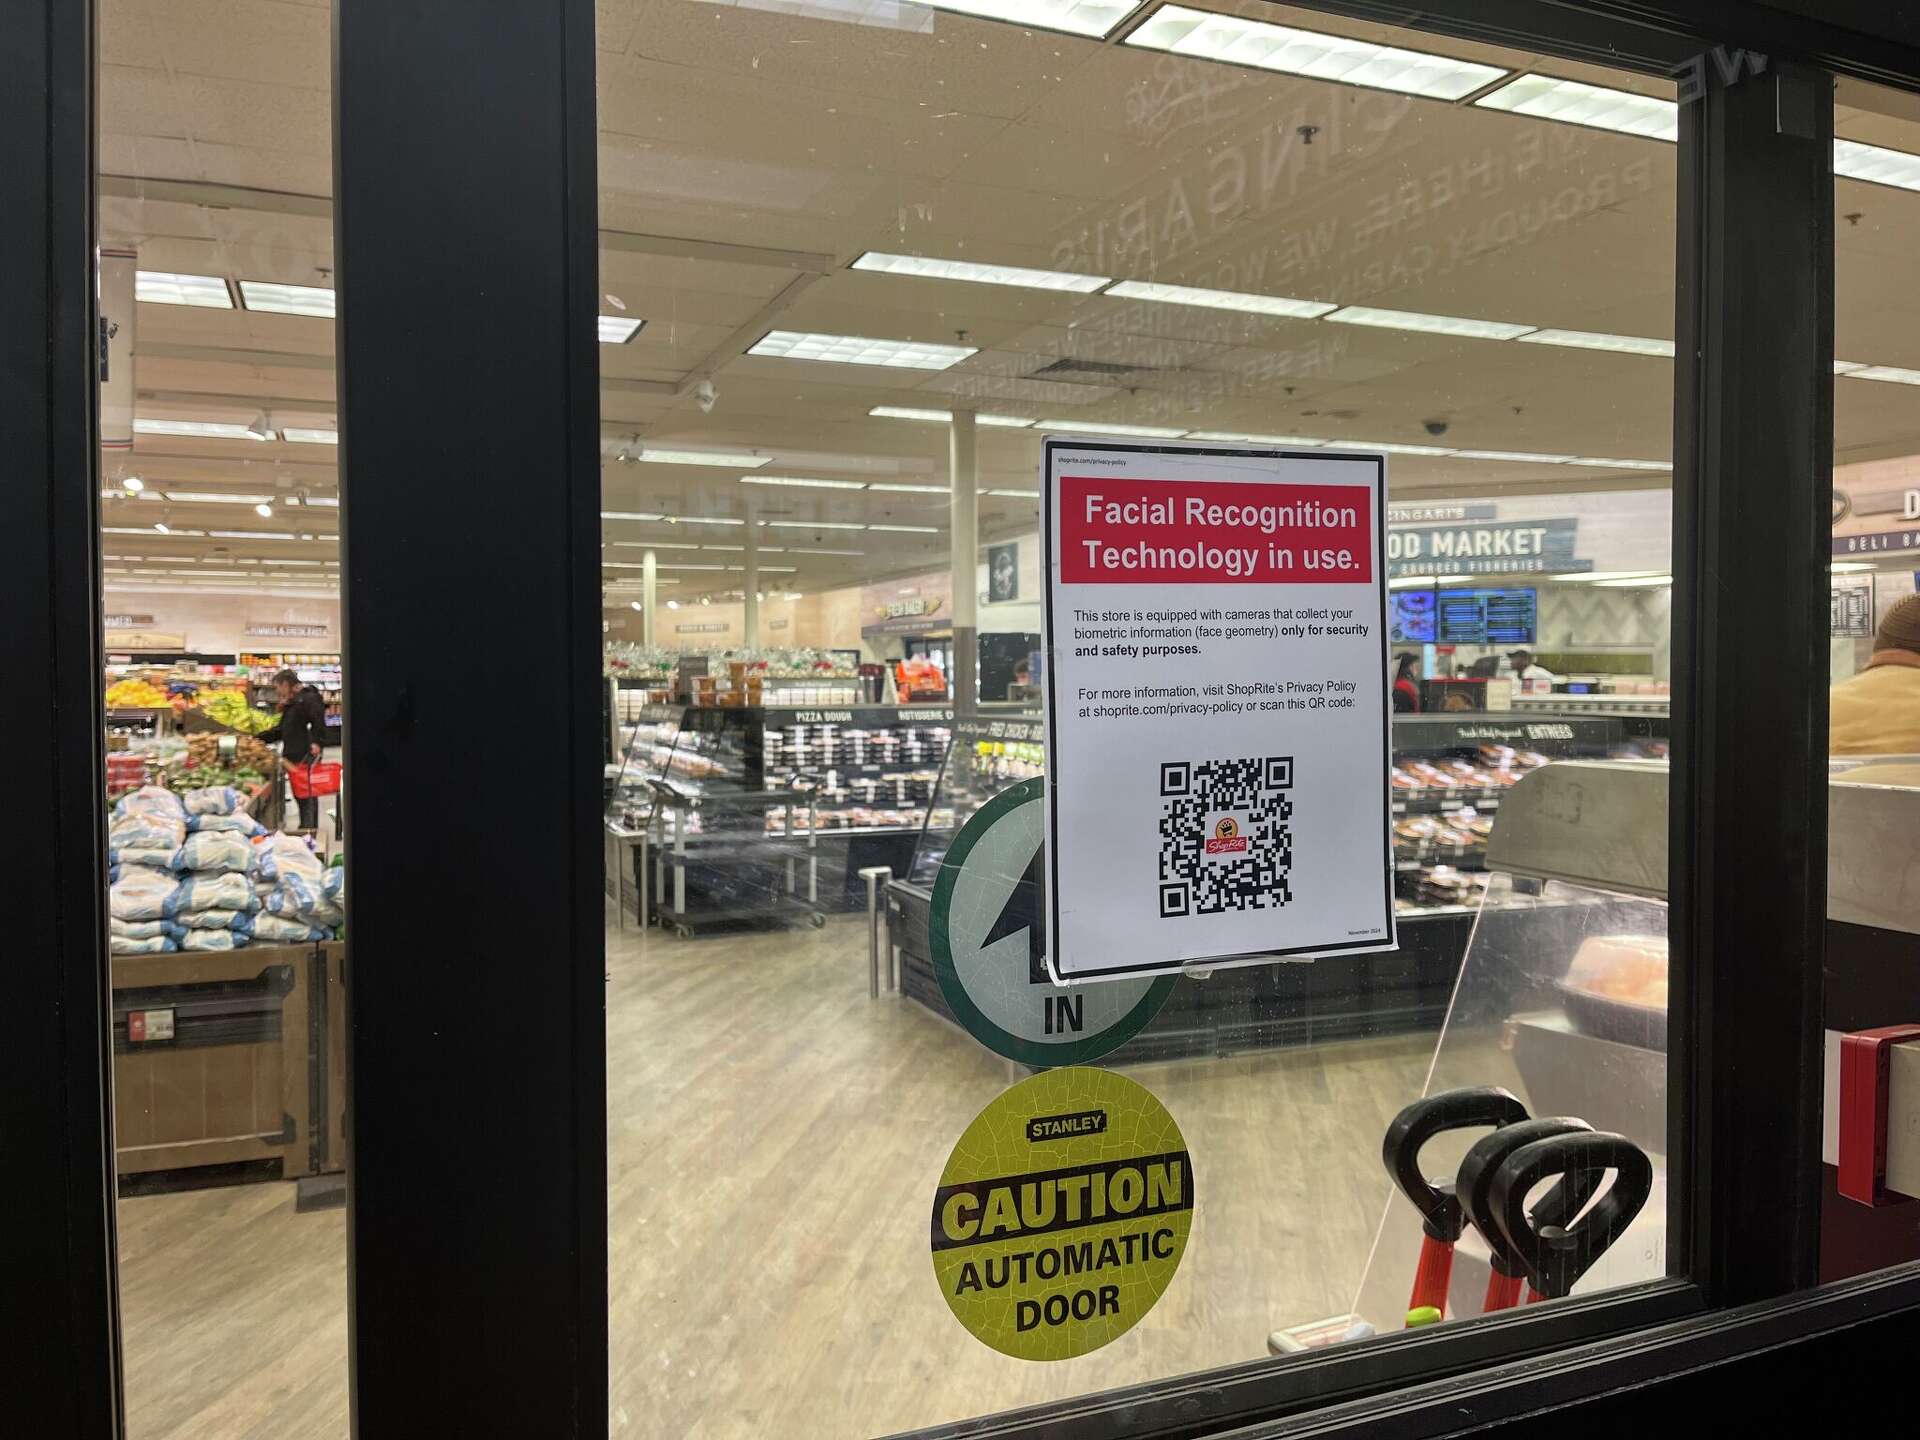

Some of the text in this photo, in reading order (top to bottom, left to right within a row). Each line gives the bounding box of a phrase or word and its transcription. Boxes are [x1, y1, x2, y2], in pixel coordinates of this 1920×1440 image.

[1086, 494, 1357, 533] Facial Recognition
[1431, 527, 1547, 558] MARKET
[1082, 540, 1361, 577] Technology in use.
[1074, 608, 1353, 623] This store is equipped with cameras that collect your
[1074, 623, 1369, 640] biometric information (face geometry) only for security
[1075, 644, 1202, 658] and safety purposes.
[1078, 680, 1357, 700] For more information, visit ShopRite's Privacy Policy
[795, 710, 852, 723] PIZZA DOUGH
[1079, 696, 1356, 719] at shoprite.com/privacy-policy or scan this QR code:
[1043, 994, 1084, 1035] IN
[1031, 1114, 1103, 1138] STANLEY
[941, 1159, 1184, 1242] CAUTION
[955, 1227, 1176, 1296] AUTOMATIC
[1016, 1284, 1121, 1333] DOOR
